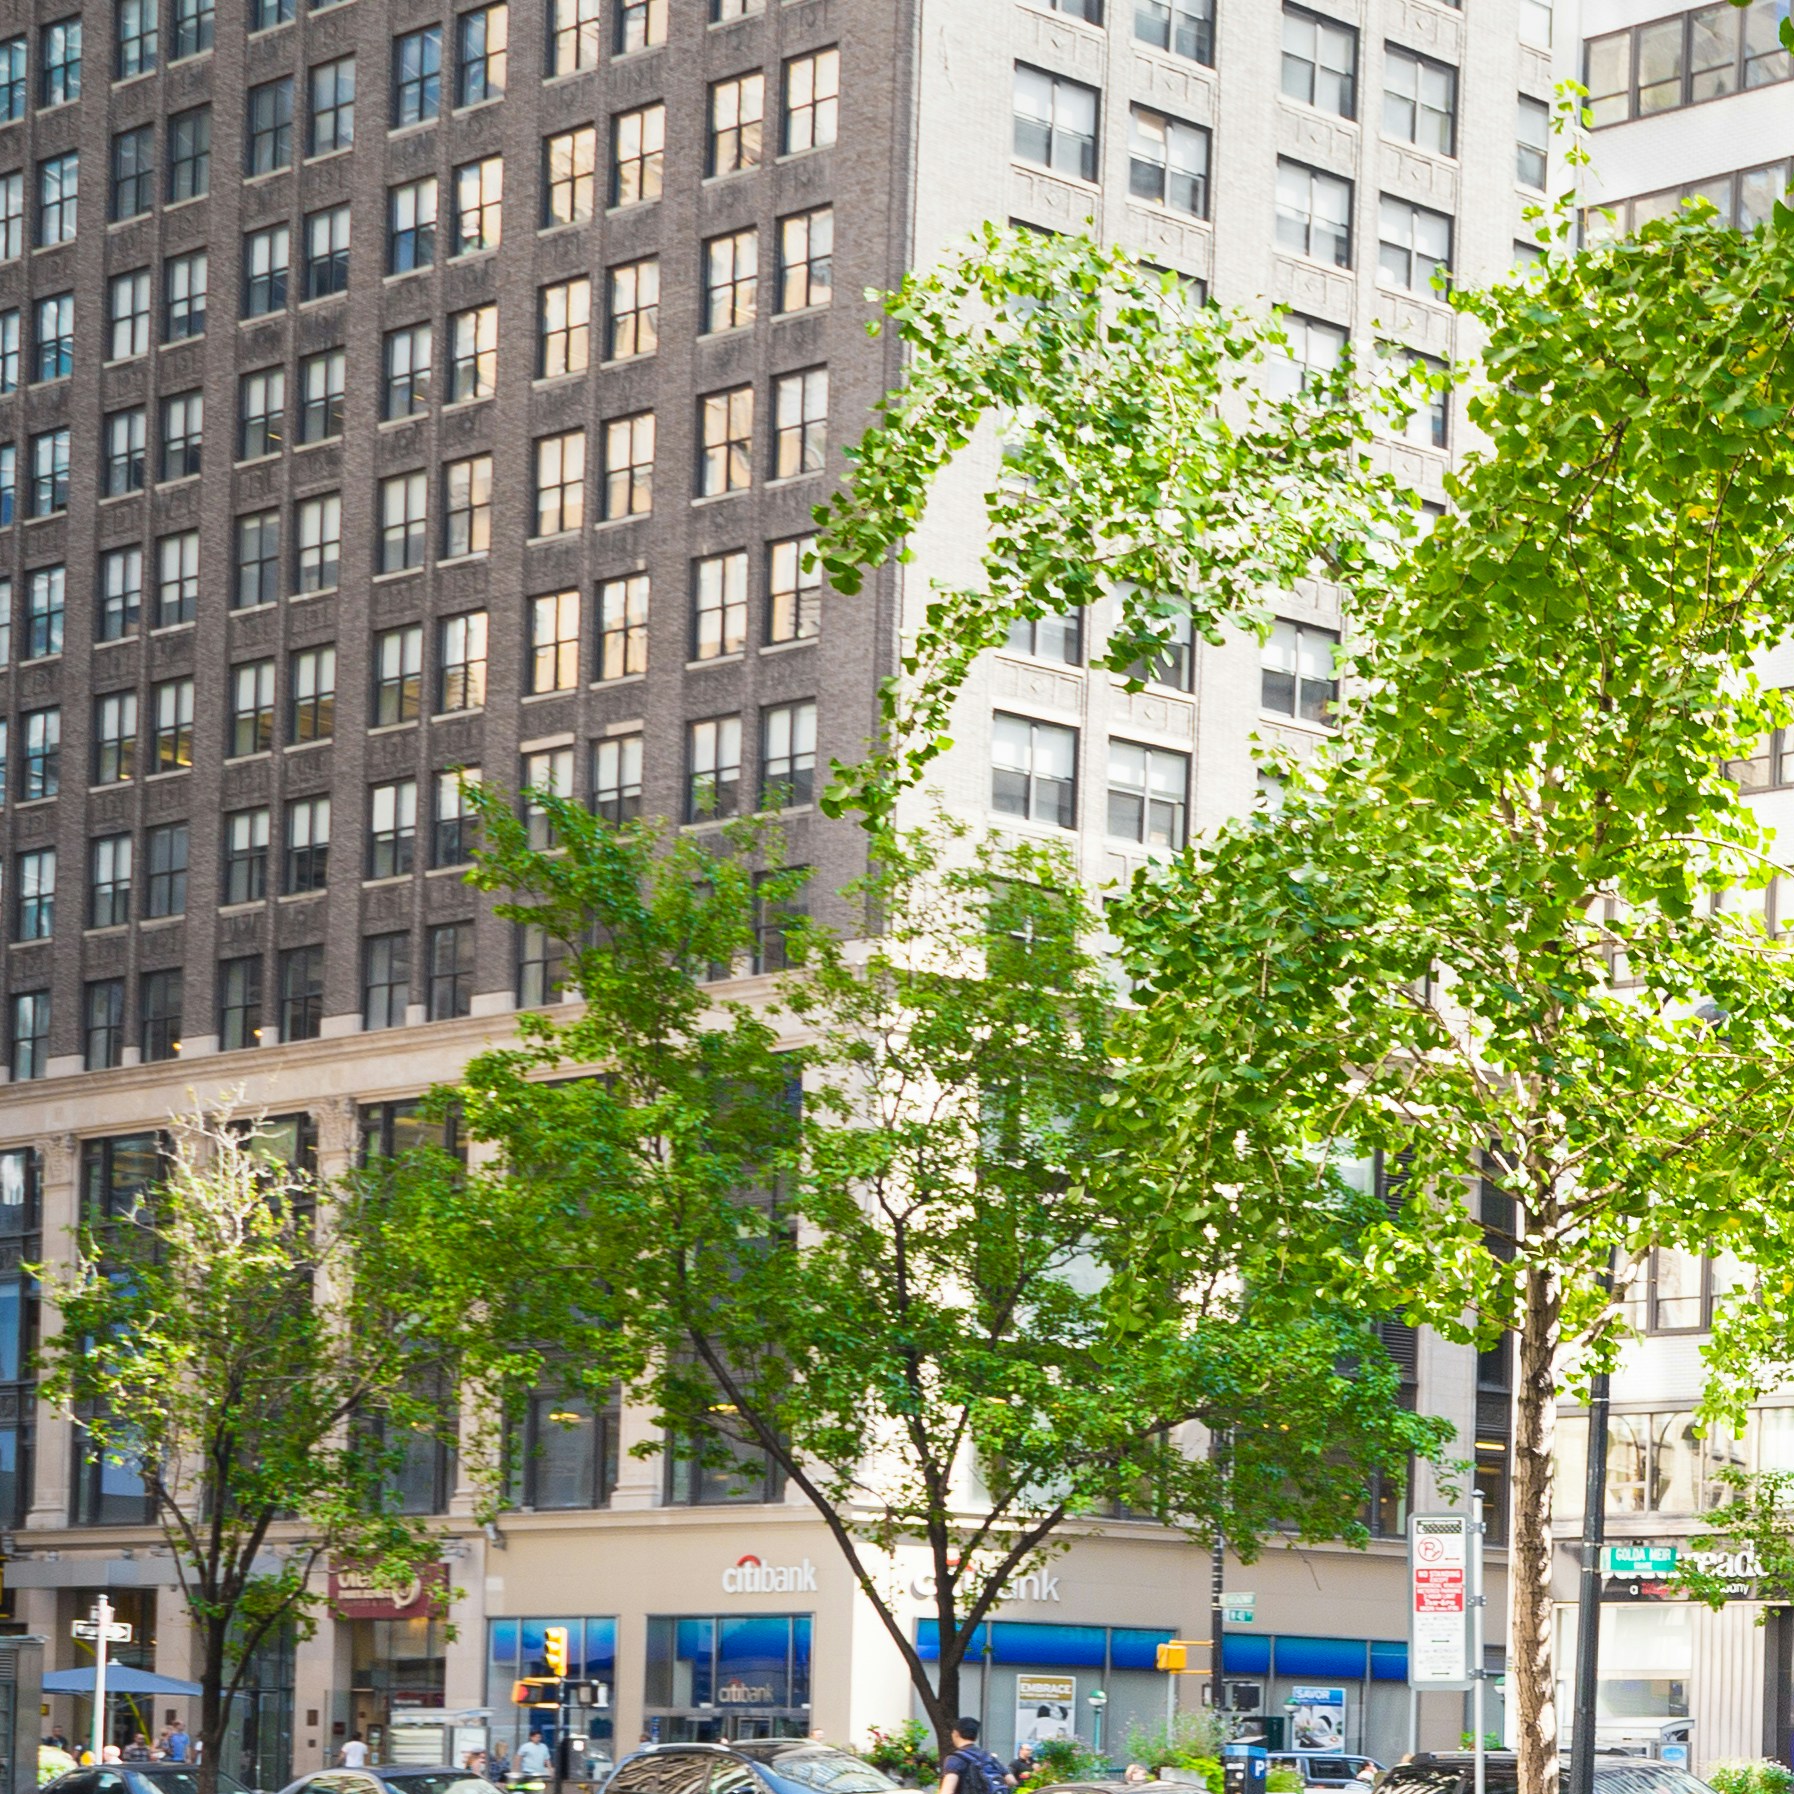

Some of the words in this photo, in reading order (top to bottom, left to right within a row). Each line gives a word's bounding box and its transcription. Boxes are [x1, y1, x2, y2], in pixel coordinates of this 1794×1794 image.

[1615, 1548, 1646, 1561] GOLDA
[1649, 1548, 1672, 1560] MEIR
[722, 1557, 817, 1594] citibank
[718, 1682, 774, 1703] citibank
[1020, 1683, 1072, 1695] EMBRACE
[1295, 1688, 1331, 1700] SAVOR
[1254, 1760, 1265, 1777] P
